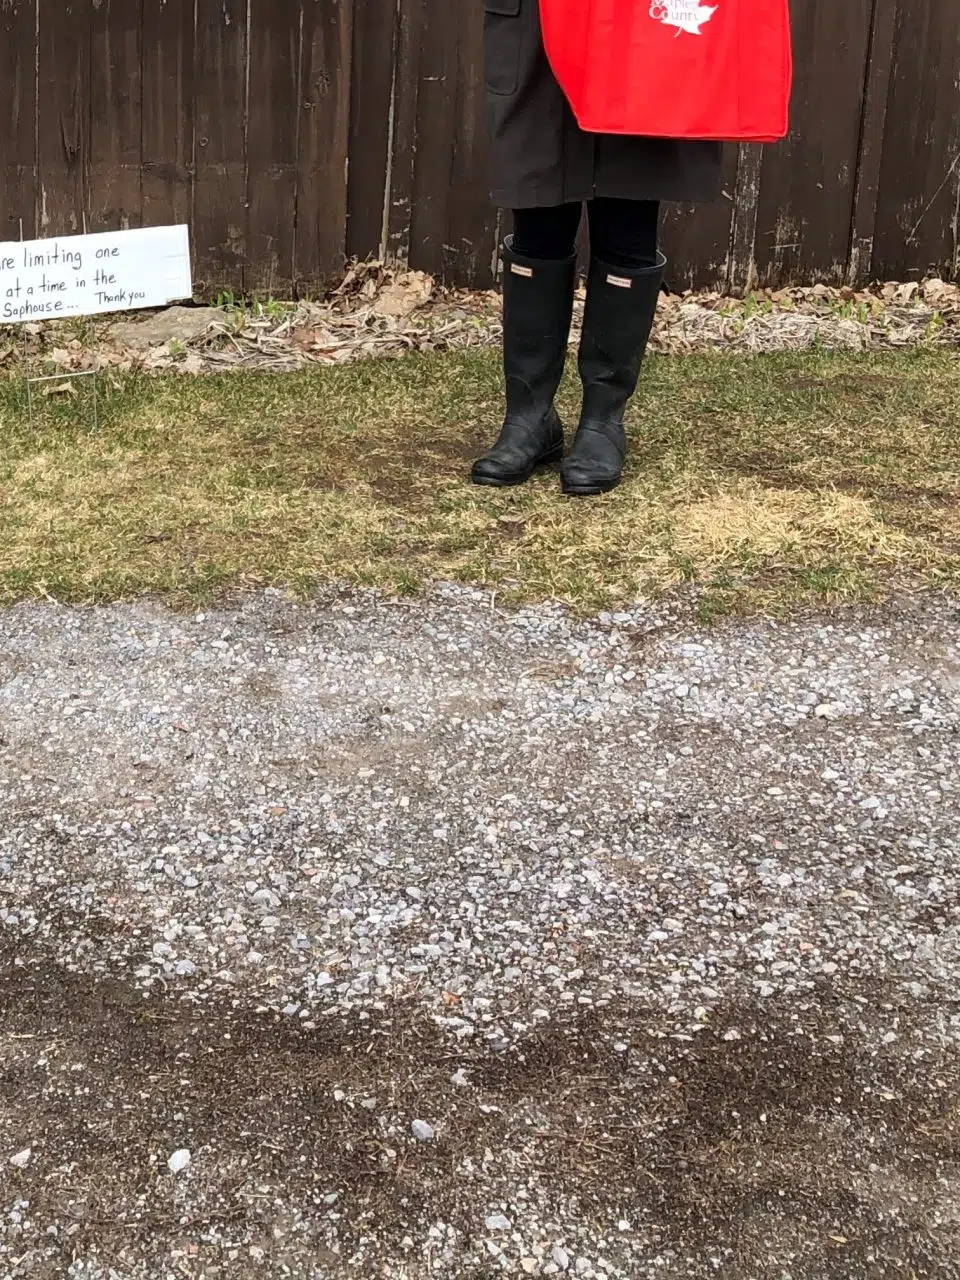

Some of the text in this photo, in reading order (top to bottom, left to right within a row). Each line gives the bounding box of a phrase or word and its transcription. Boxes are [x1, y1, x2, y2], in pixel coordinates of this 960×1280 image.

[23, 243, 82, 270] limiting
[95, 247, 121, 259] one
[6, 277, 23, 298] at
[26, 285, 34, 296] a
[38, 274, 68, 295] time
[75, 277, 86, 289] in
[93, 269, 117, 288] the
[94, 290, 127, 306] Thank
[126, 291, 146, 307] you
